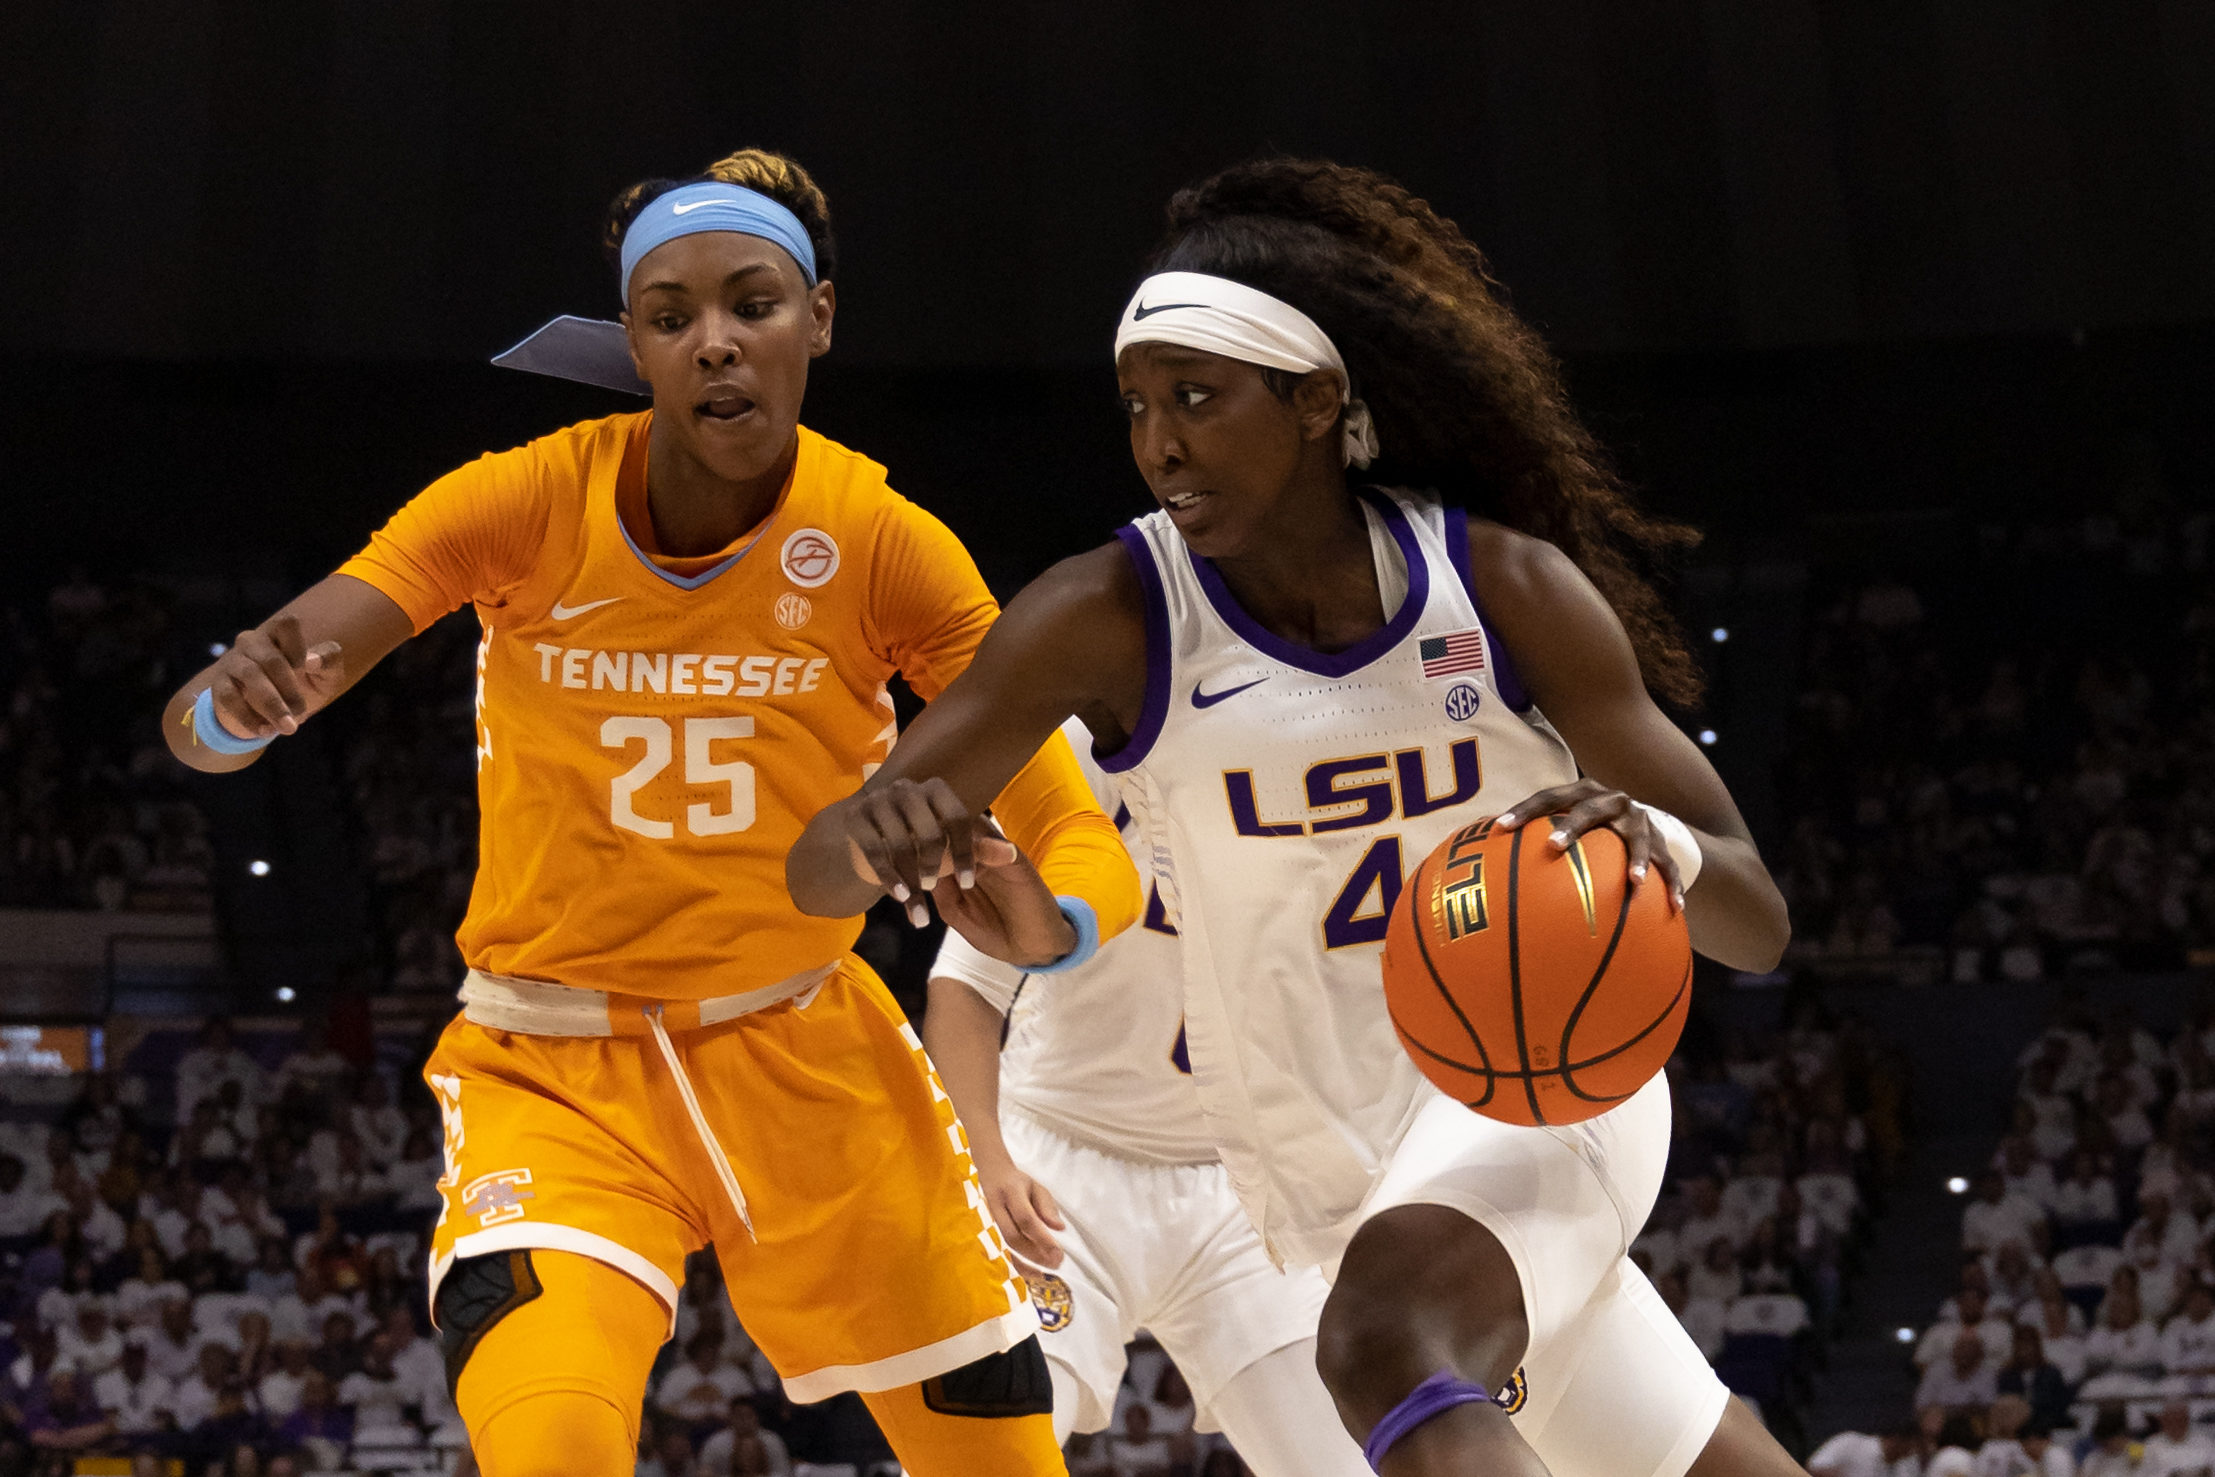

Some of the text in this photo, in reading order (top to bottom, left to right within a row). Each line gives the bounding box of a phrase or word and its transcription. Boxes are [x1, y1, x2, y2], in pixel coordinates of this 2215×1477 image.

[778, 594, 809, 627] SEC
[534, 643, 829, 697] TENNESSEE
[1447, 685, 1478, 720] SEC
[600, 716, 756, 839] 25
[1222, 737, 1482, 838] LSU
[1321, 834, 1406, 951] 4
[1442, 817, 1498, 943] ELITE
